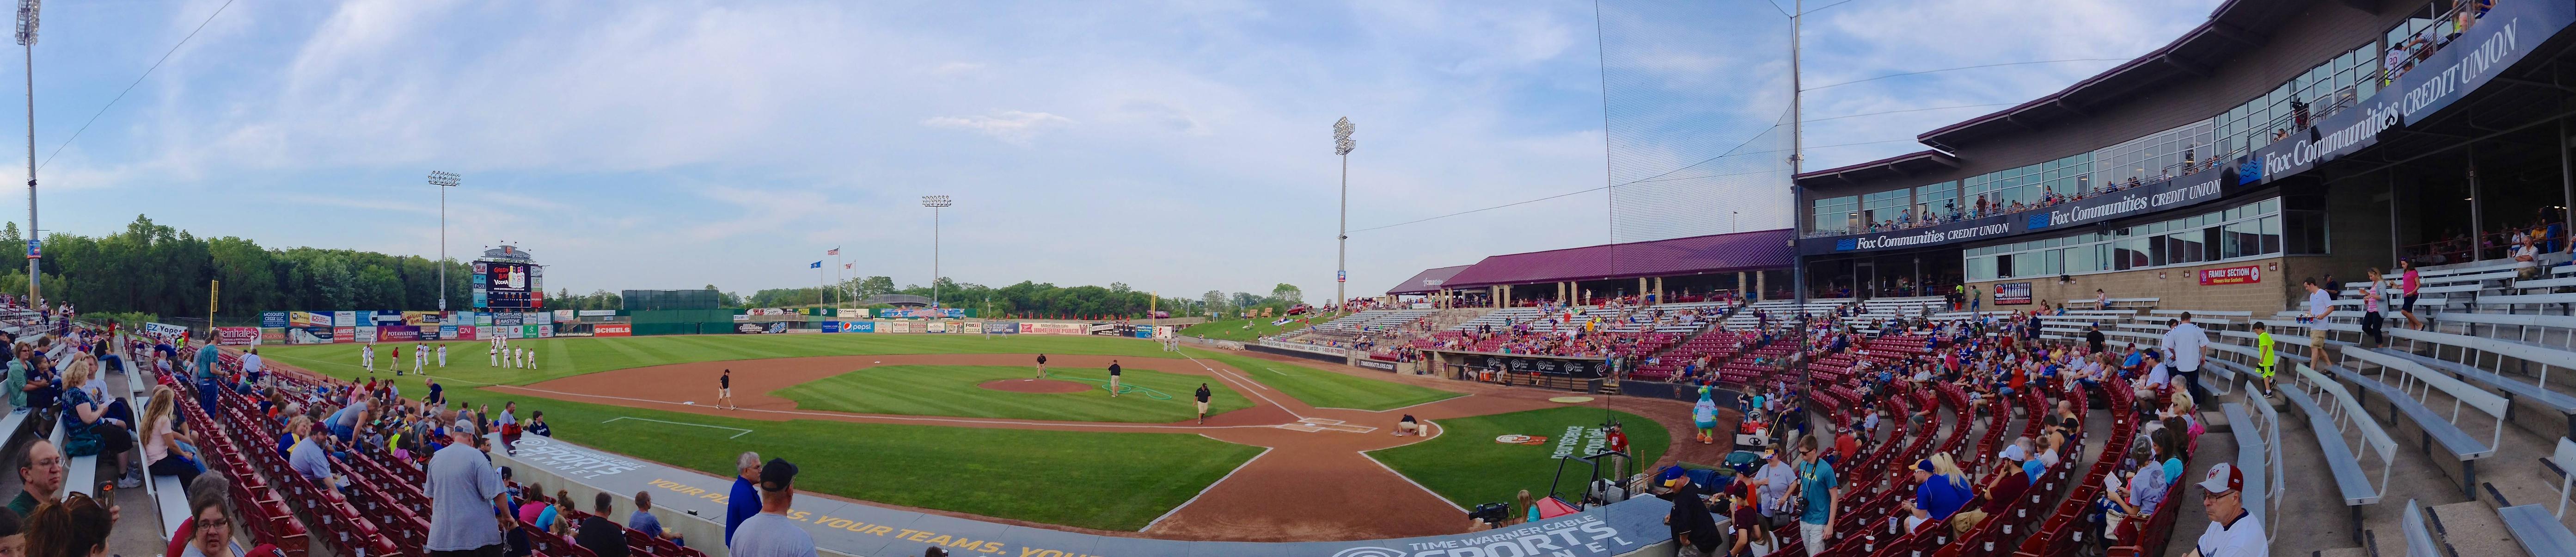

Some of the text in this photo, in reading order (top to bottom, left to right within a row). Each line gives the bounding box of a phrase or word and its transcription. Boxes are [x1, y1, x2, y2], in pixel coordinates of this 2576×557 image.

[2389, 56, 2397, 66] 20
[2264, 150, 2292, 178] Fox
[2403, 66, 2459, 118] CREDIT
[2462, 18, 2517, 85] UNION
[2050, 178, 2221, 226] Fox Communities CREDIT UNION
[1856, 223, 2009, 249] Fox Communities CREDIT UNION
[2208, 270, 2226, 278] FAMILY
[1360, 360, 1394, 370] TIMBERRATTLERS.COM
[527, 446, 637, 475] SPORTS
[608, 457, 647, 470] CABLE
[647, 478, 705, 496] YOUR
[814, 515, 893, 537] YOUR
[895, 528, 1007, 555] TEAMS.
[1409, 515, 1597, 551] TIME WARNER CABLE
